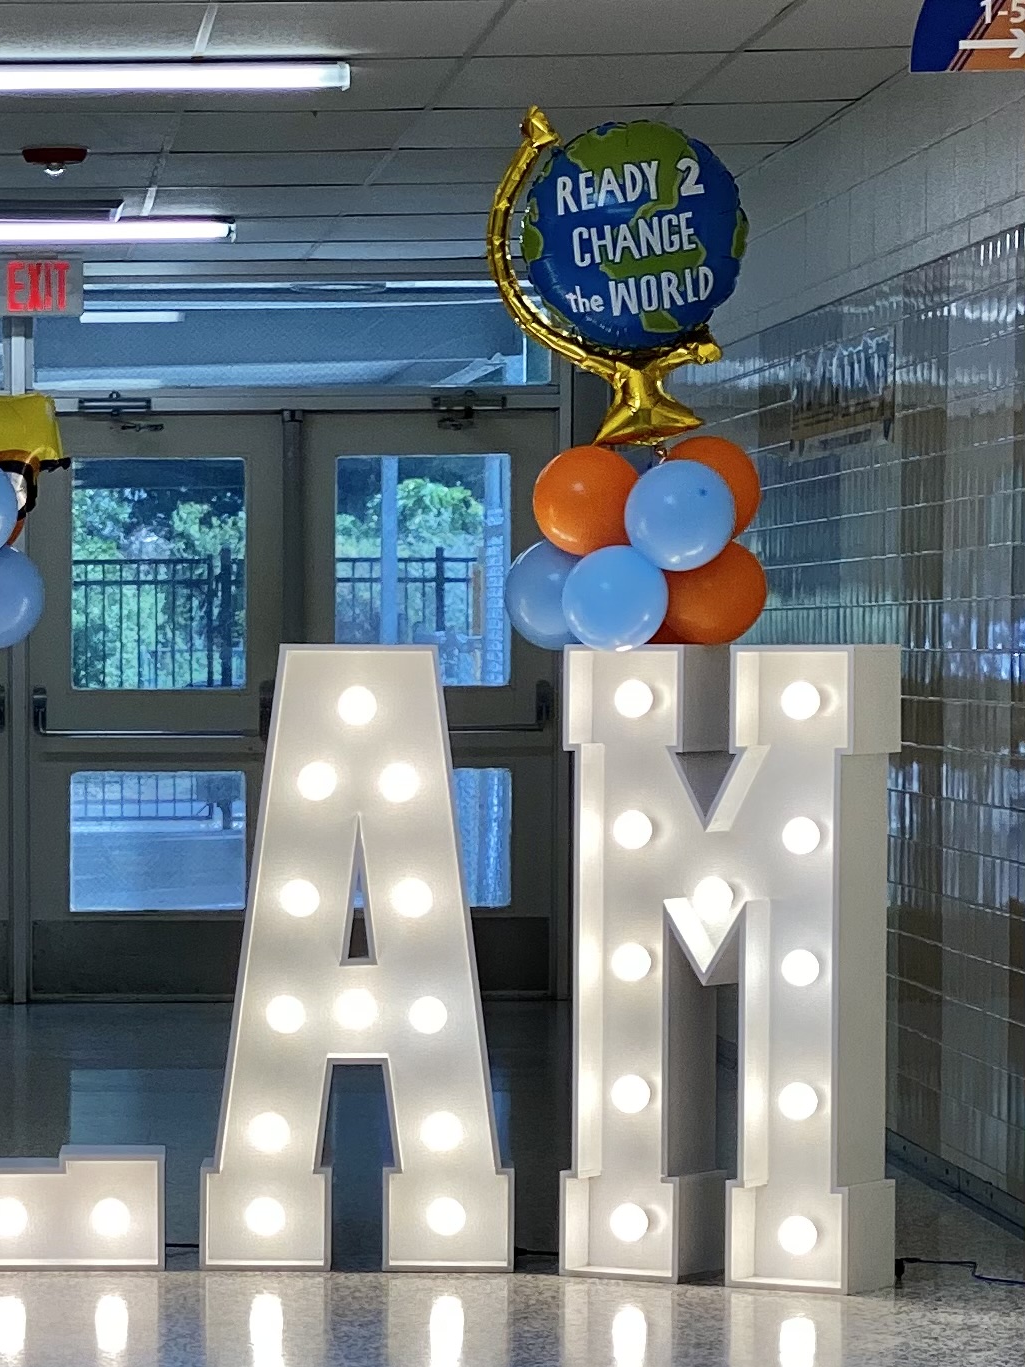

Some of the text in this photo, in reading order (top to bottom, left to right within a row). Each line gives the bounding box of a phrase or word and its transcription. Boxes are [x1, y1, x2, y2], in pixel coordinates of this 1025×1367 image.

[556, 157, 705, 216] READY 2
[572, 211, 697, 268] CHANGE
[7, 260, 70, 312] EXIT
[565, 265, 715, 317] the WORLD
